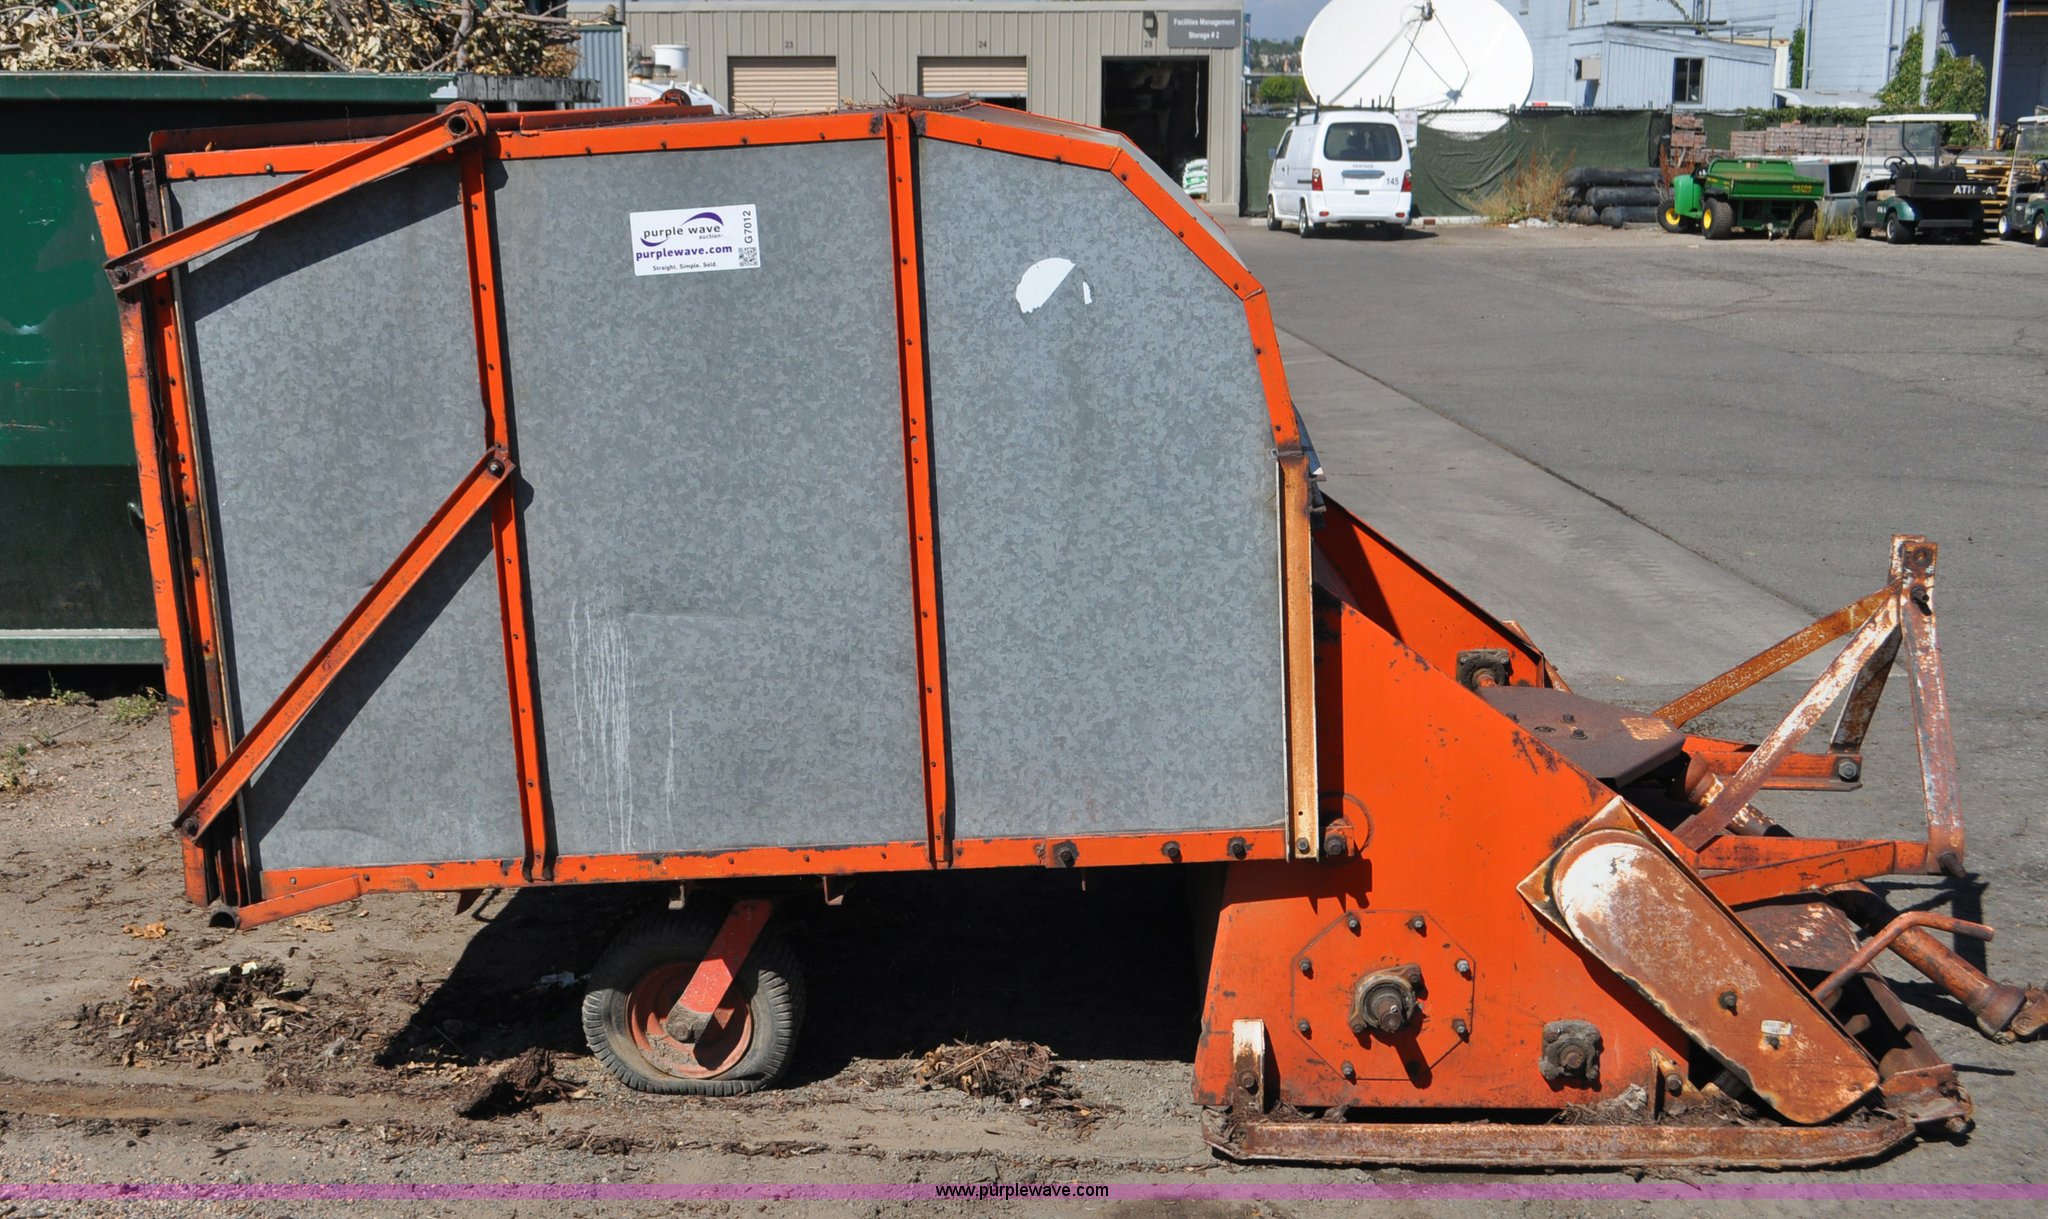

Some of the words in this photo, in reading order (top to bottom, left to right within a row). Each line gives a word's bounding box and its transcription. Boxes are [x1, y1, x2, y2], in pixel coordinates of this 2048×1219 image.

[1173, 18, 1198, 26] Facilities
[1200, 18, 1235, 27] Management
[1188, 31, 1210, 40] Storage
[978, 41, 987, 49] 24
[1386, 177, 1399, 185] 145
[742, 210, 753, 244] G7012
[643, 226, 684, 239] purple
[688, 225, 721, 234] wave
[636, 245, 733, 261] purplewave.com
